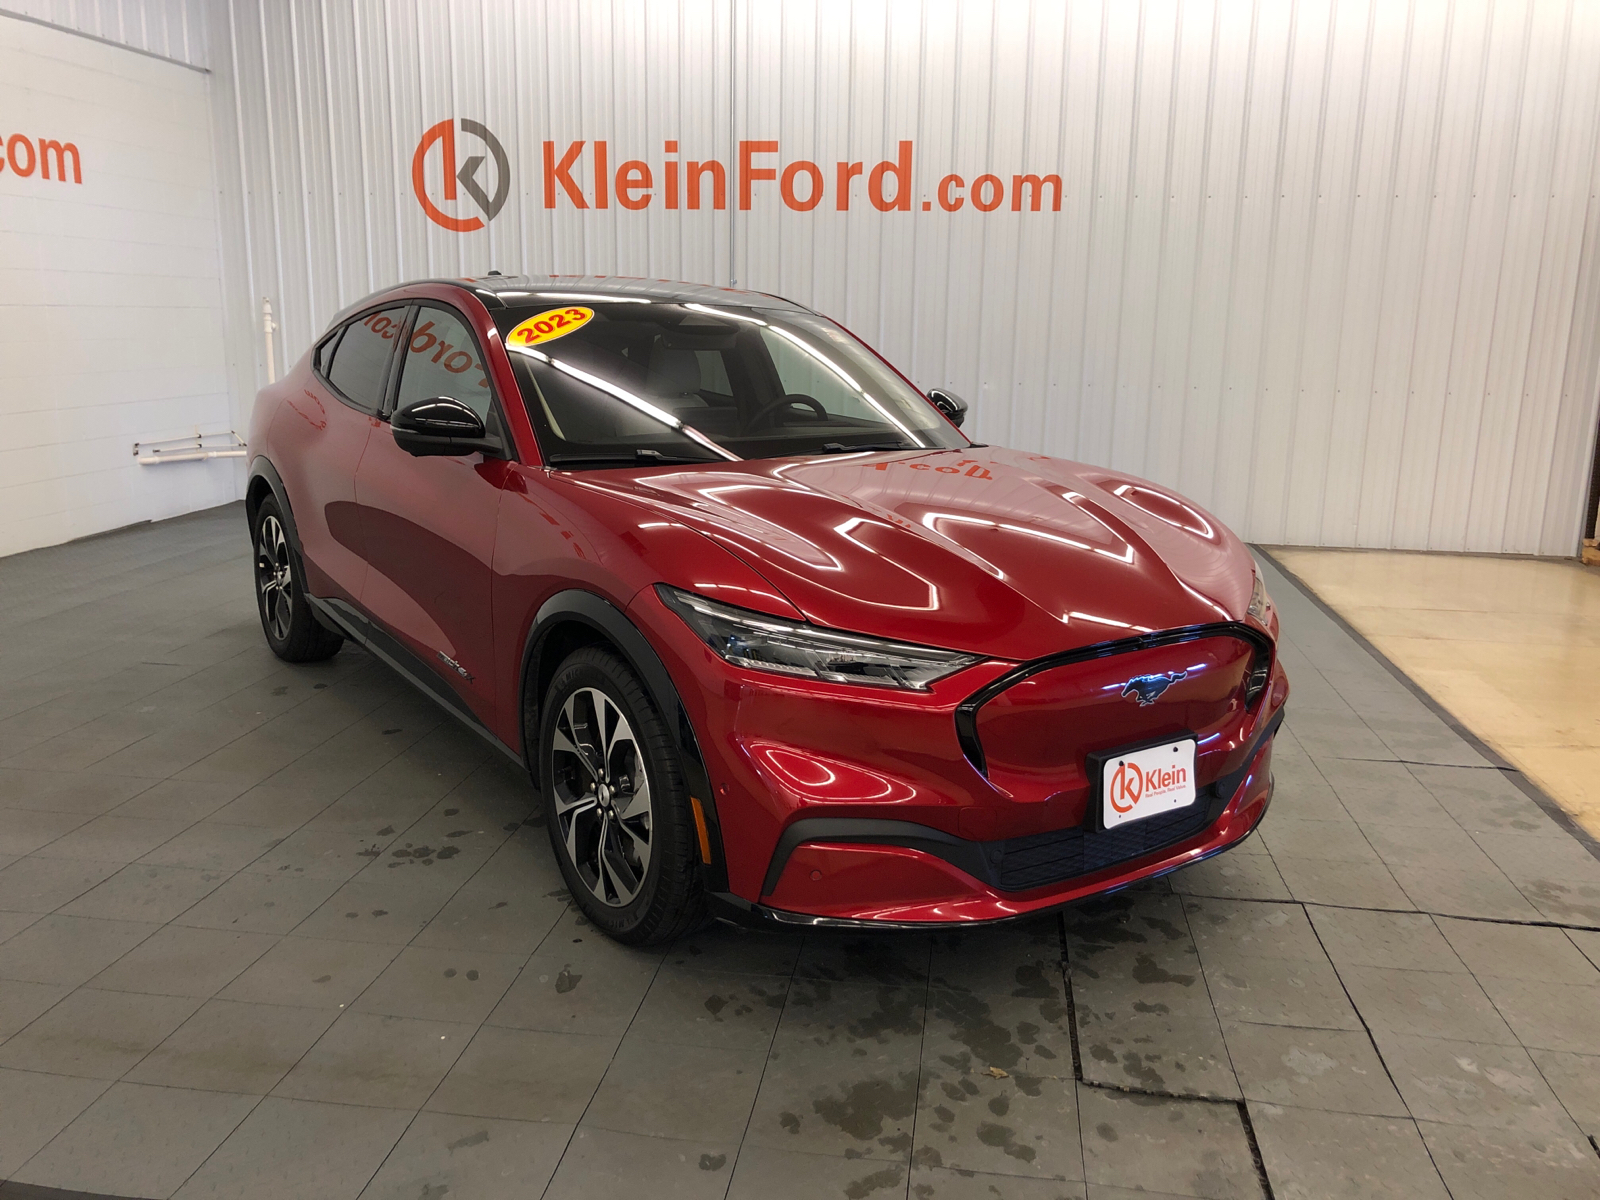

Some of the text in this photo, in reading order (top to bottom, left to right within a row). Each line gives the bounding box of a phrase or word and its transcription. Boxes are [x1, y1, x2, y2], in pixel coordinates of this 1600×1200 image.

[0, 133, 82, 184] om
[543, 140, 1063, 212] KleinFord.com
[516, 308, 588, 344] 2023
[1145, 764, 1187, 793] Klein
